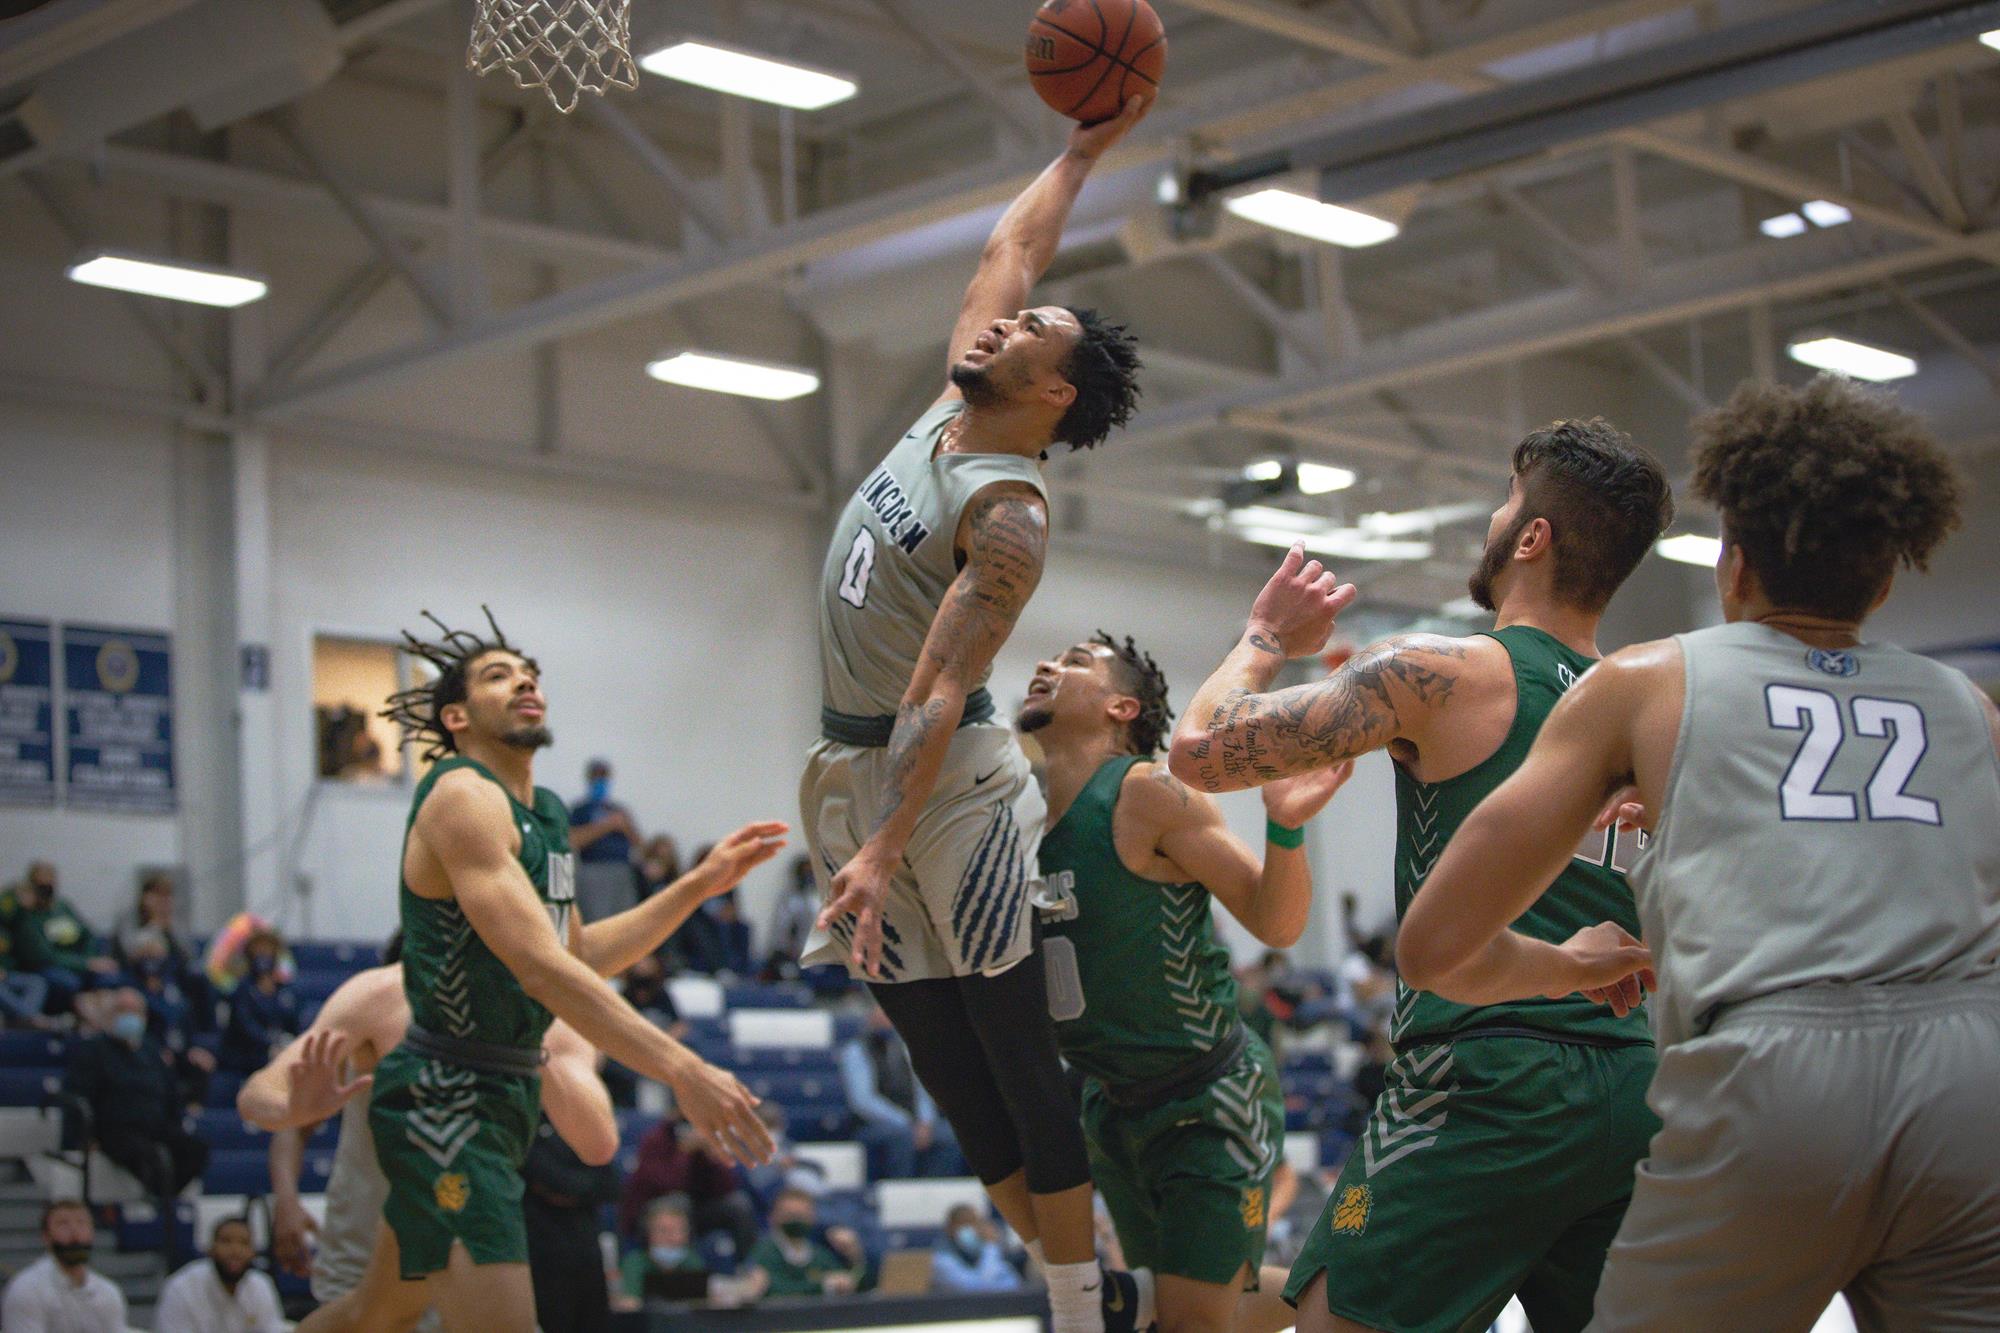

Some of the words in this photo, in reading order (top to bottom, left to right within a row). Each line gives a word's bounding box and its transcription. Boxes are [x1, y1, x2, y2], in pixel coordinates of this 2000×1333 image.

[859, 466, 931, 554] INCOLN
[838, 525, 875, 609] 0
[1764, 682, 1942, 826] 22
